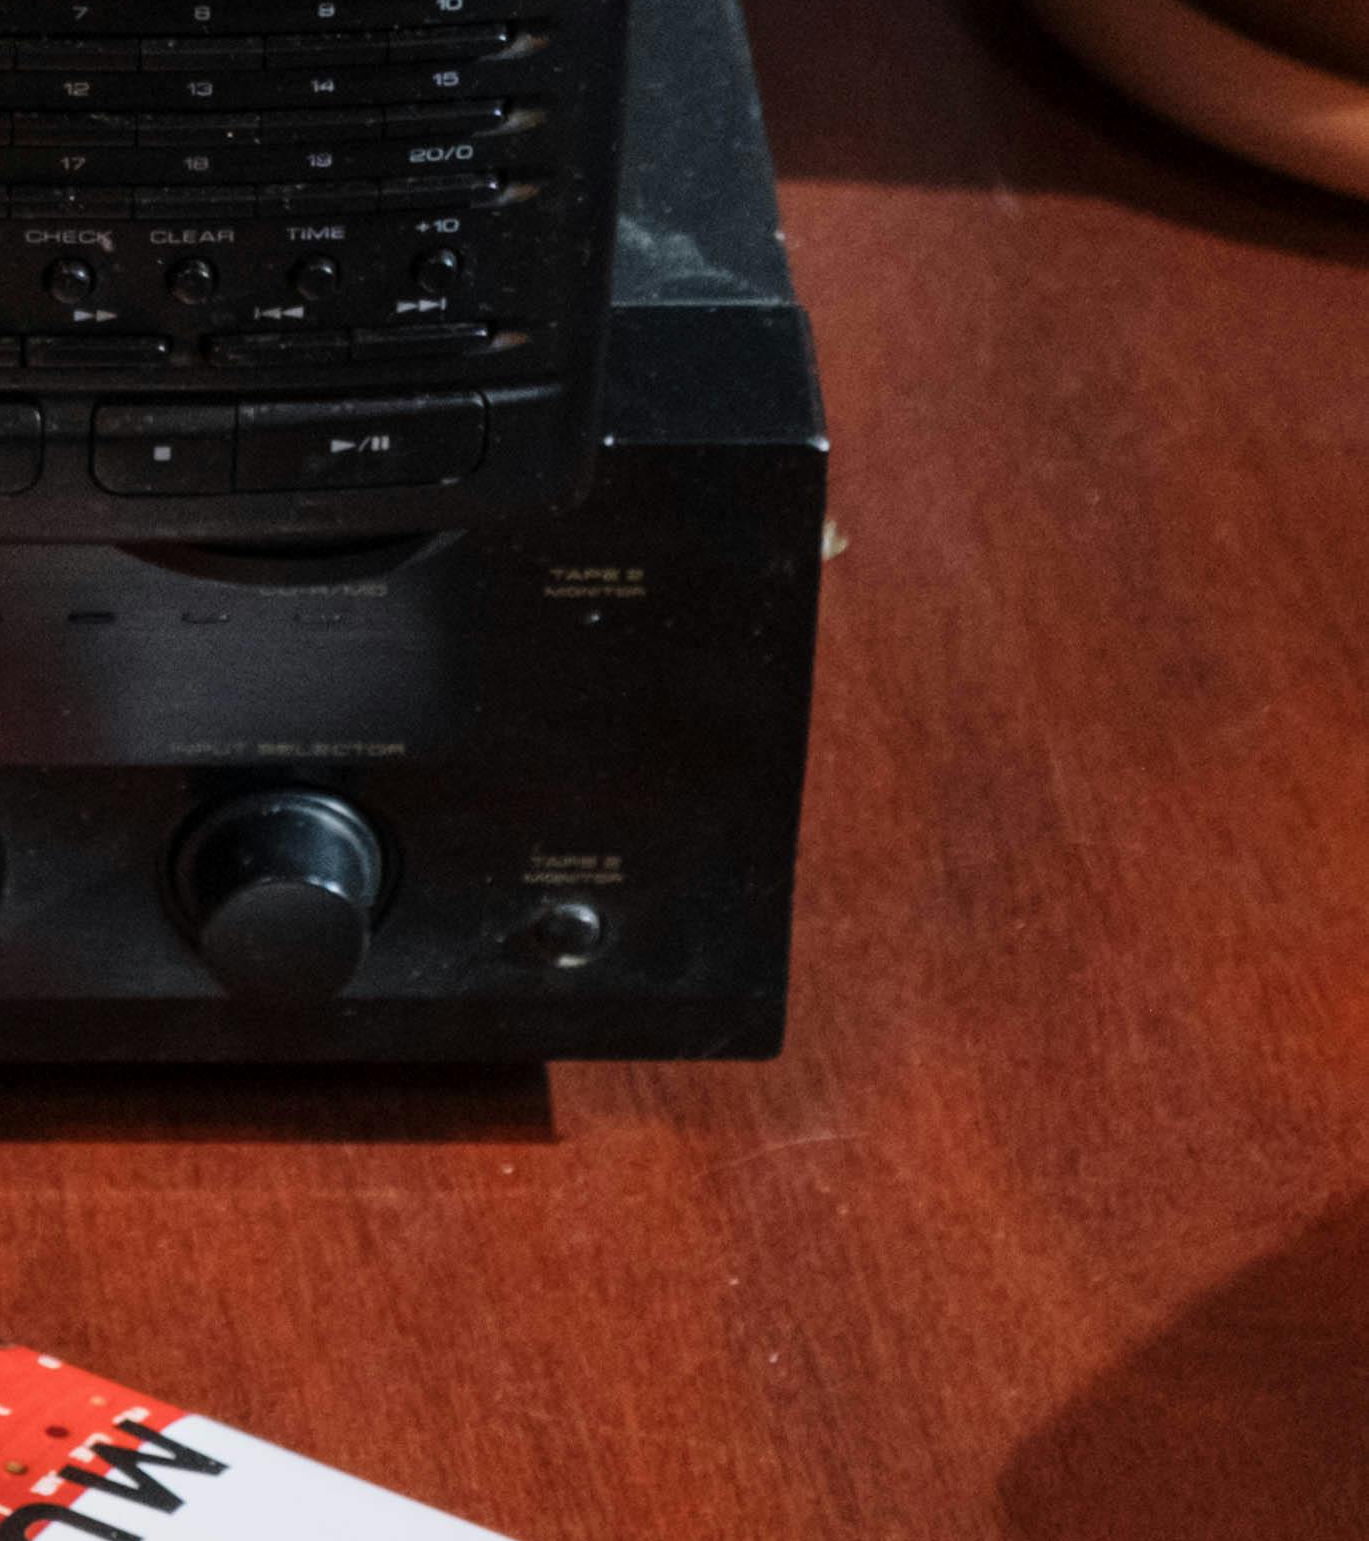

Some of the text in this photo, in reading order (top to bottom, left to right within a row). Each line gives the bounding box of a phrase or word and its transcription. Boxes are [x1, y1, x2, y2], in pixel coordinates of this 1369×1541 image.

[72, 6, 88, 21] 7
[63, 81, 90, 96] 12
[187, 81, 213, 97] 13
[310, 78, 335, 94] 14
[432, 71, 459, 87] 15
[60, 156, 85, 171] 17
[183, 156, 209, 172] 18
[307, 152, 333, 169] 19
[408, 145, 474, 164] 20/0
[286, 224, 345, 241] TIME
[414, 218, 460, 234] +10
[25, 228, 113, 245] CHECK
[150, 228, 235, 244] CLEAR
[542, 584, 648, 599] MONITOR
